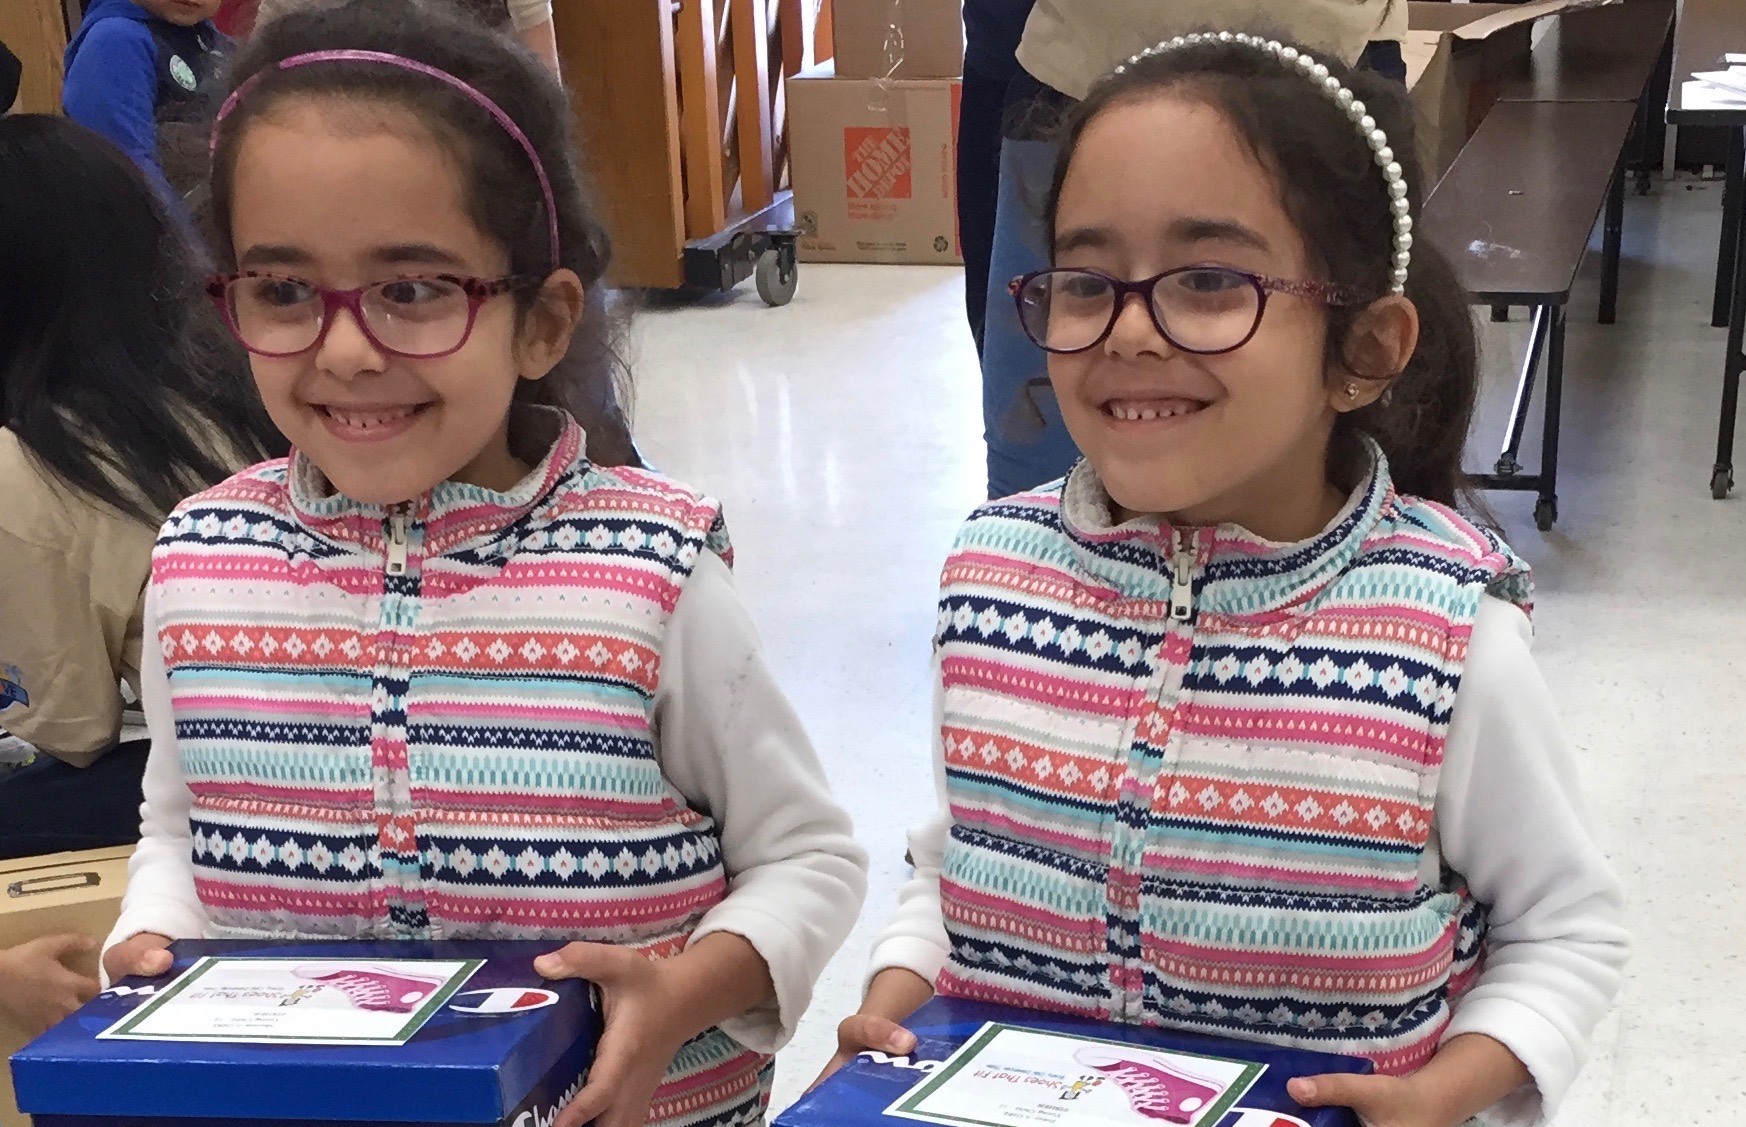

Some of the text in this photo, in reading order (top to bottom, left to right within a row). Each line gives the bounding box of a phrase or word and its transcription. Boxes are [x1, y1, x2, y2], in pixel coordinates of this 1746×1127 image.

[847, 127, 911, 199] HOME
[973, 1069, 991, 1079] Fit
[992, 1072, 1020, 1083] That
[1023, 1076, 1062, 1089] Shoes
